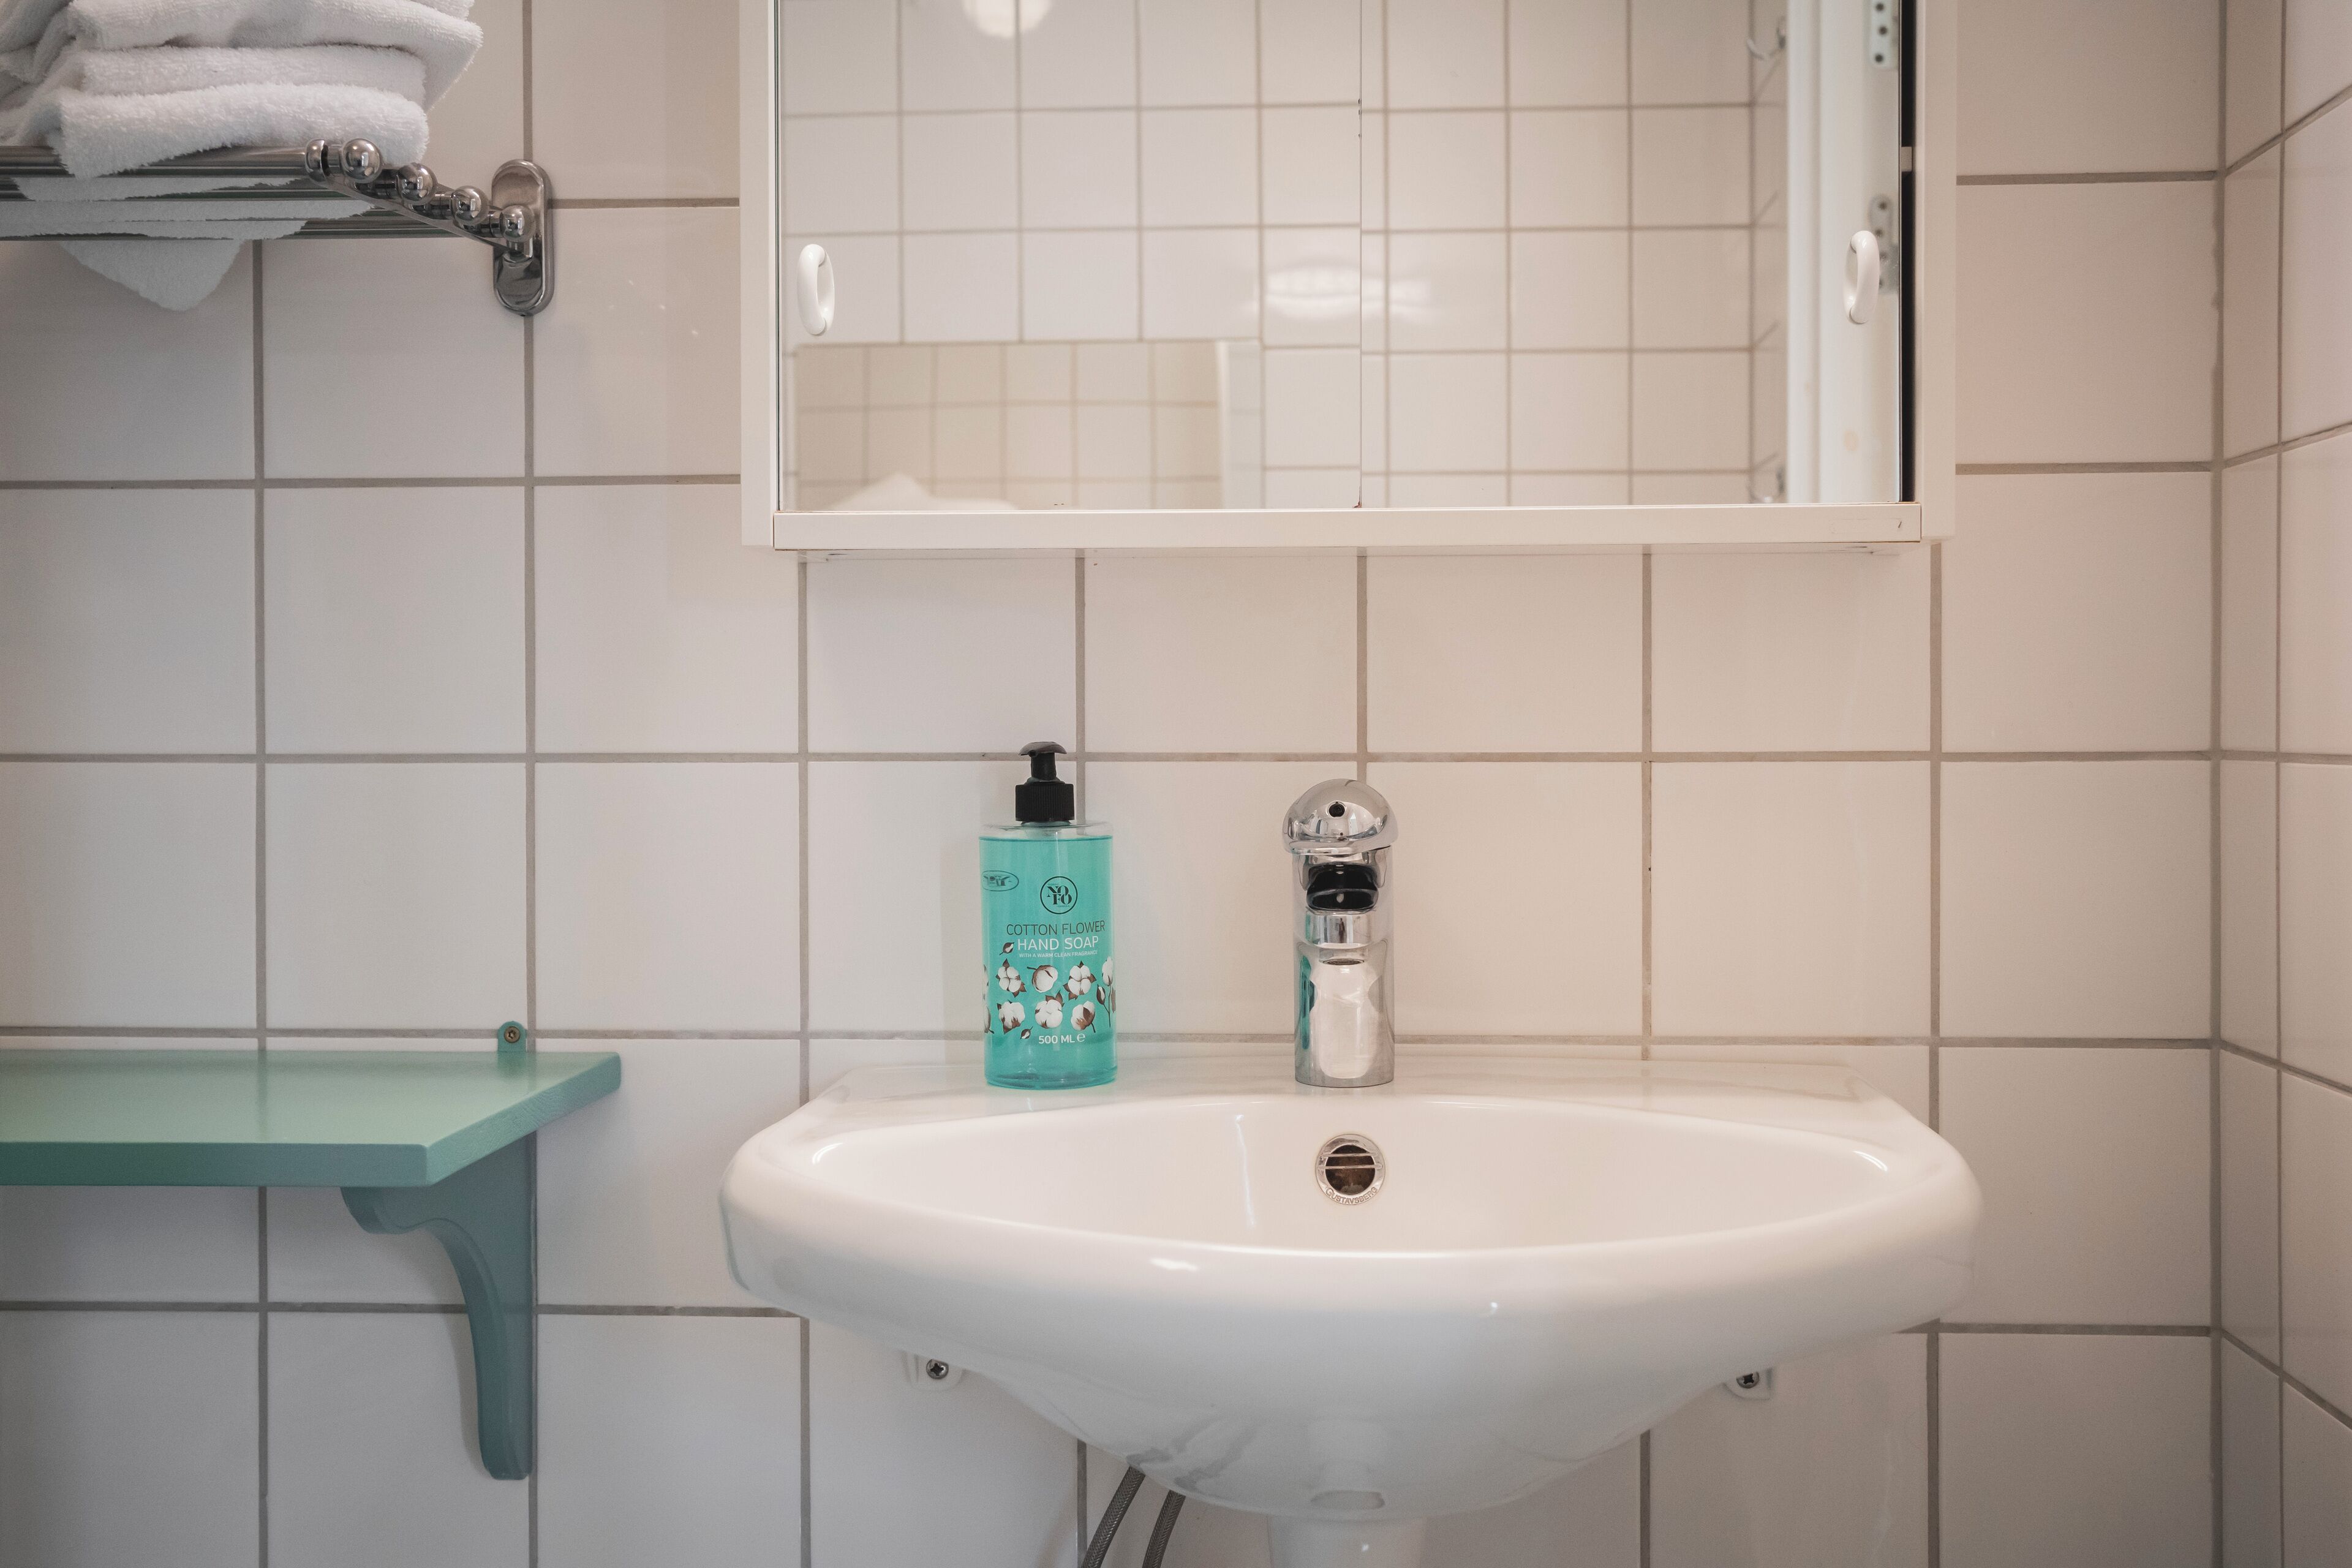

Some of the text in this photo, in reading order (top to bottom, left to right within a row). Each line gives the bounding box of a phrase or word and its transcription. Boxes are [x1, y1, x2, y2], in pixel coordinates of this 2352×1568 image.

[1006, 920, 1105, 935] COTTON FLOWER
[1018, 936, 1098, 950] HAND SOAP
[1039, 1035, 1058, 1044] 500
[1061, 1035, 1075, 1043] ML
[1325, 1187, 1378, 1204] GUSTAVSBERG
